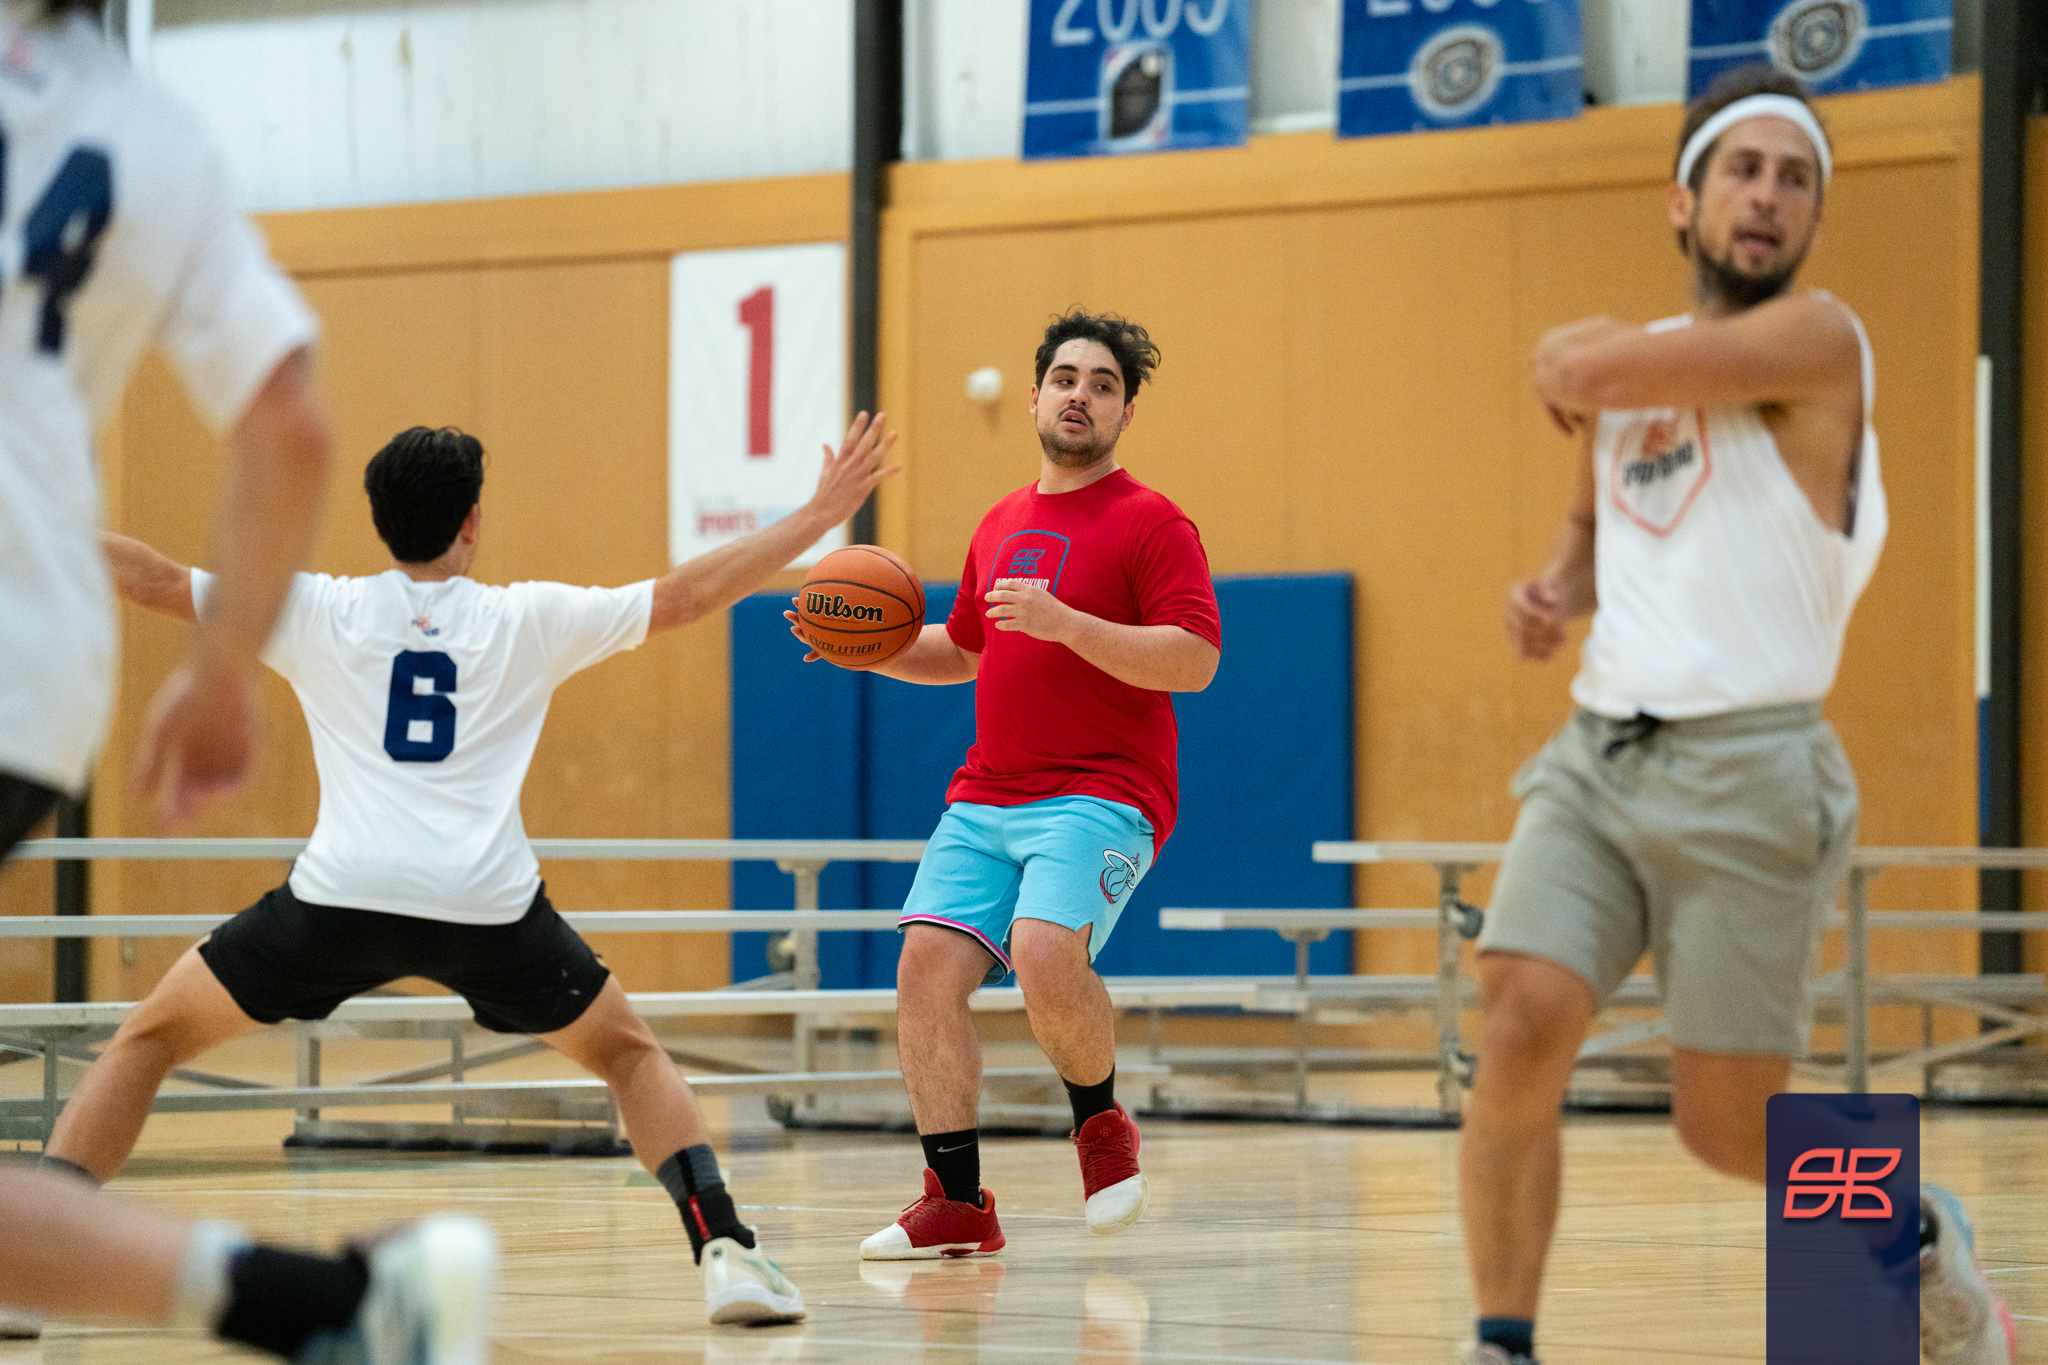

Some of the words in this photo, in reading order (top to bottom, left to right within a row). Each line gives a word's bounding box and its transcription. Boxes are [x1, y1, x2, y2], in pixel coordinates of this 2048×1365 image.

[738, 287, 774, 458] 1
[806, 591, 883, 623] Wilson
[808, 634, 882, 655] EVOLUTION
[383, 649, 457, 762] 6
